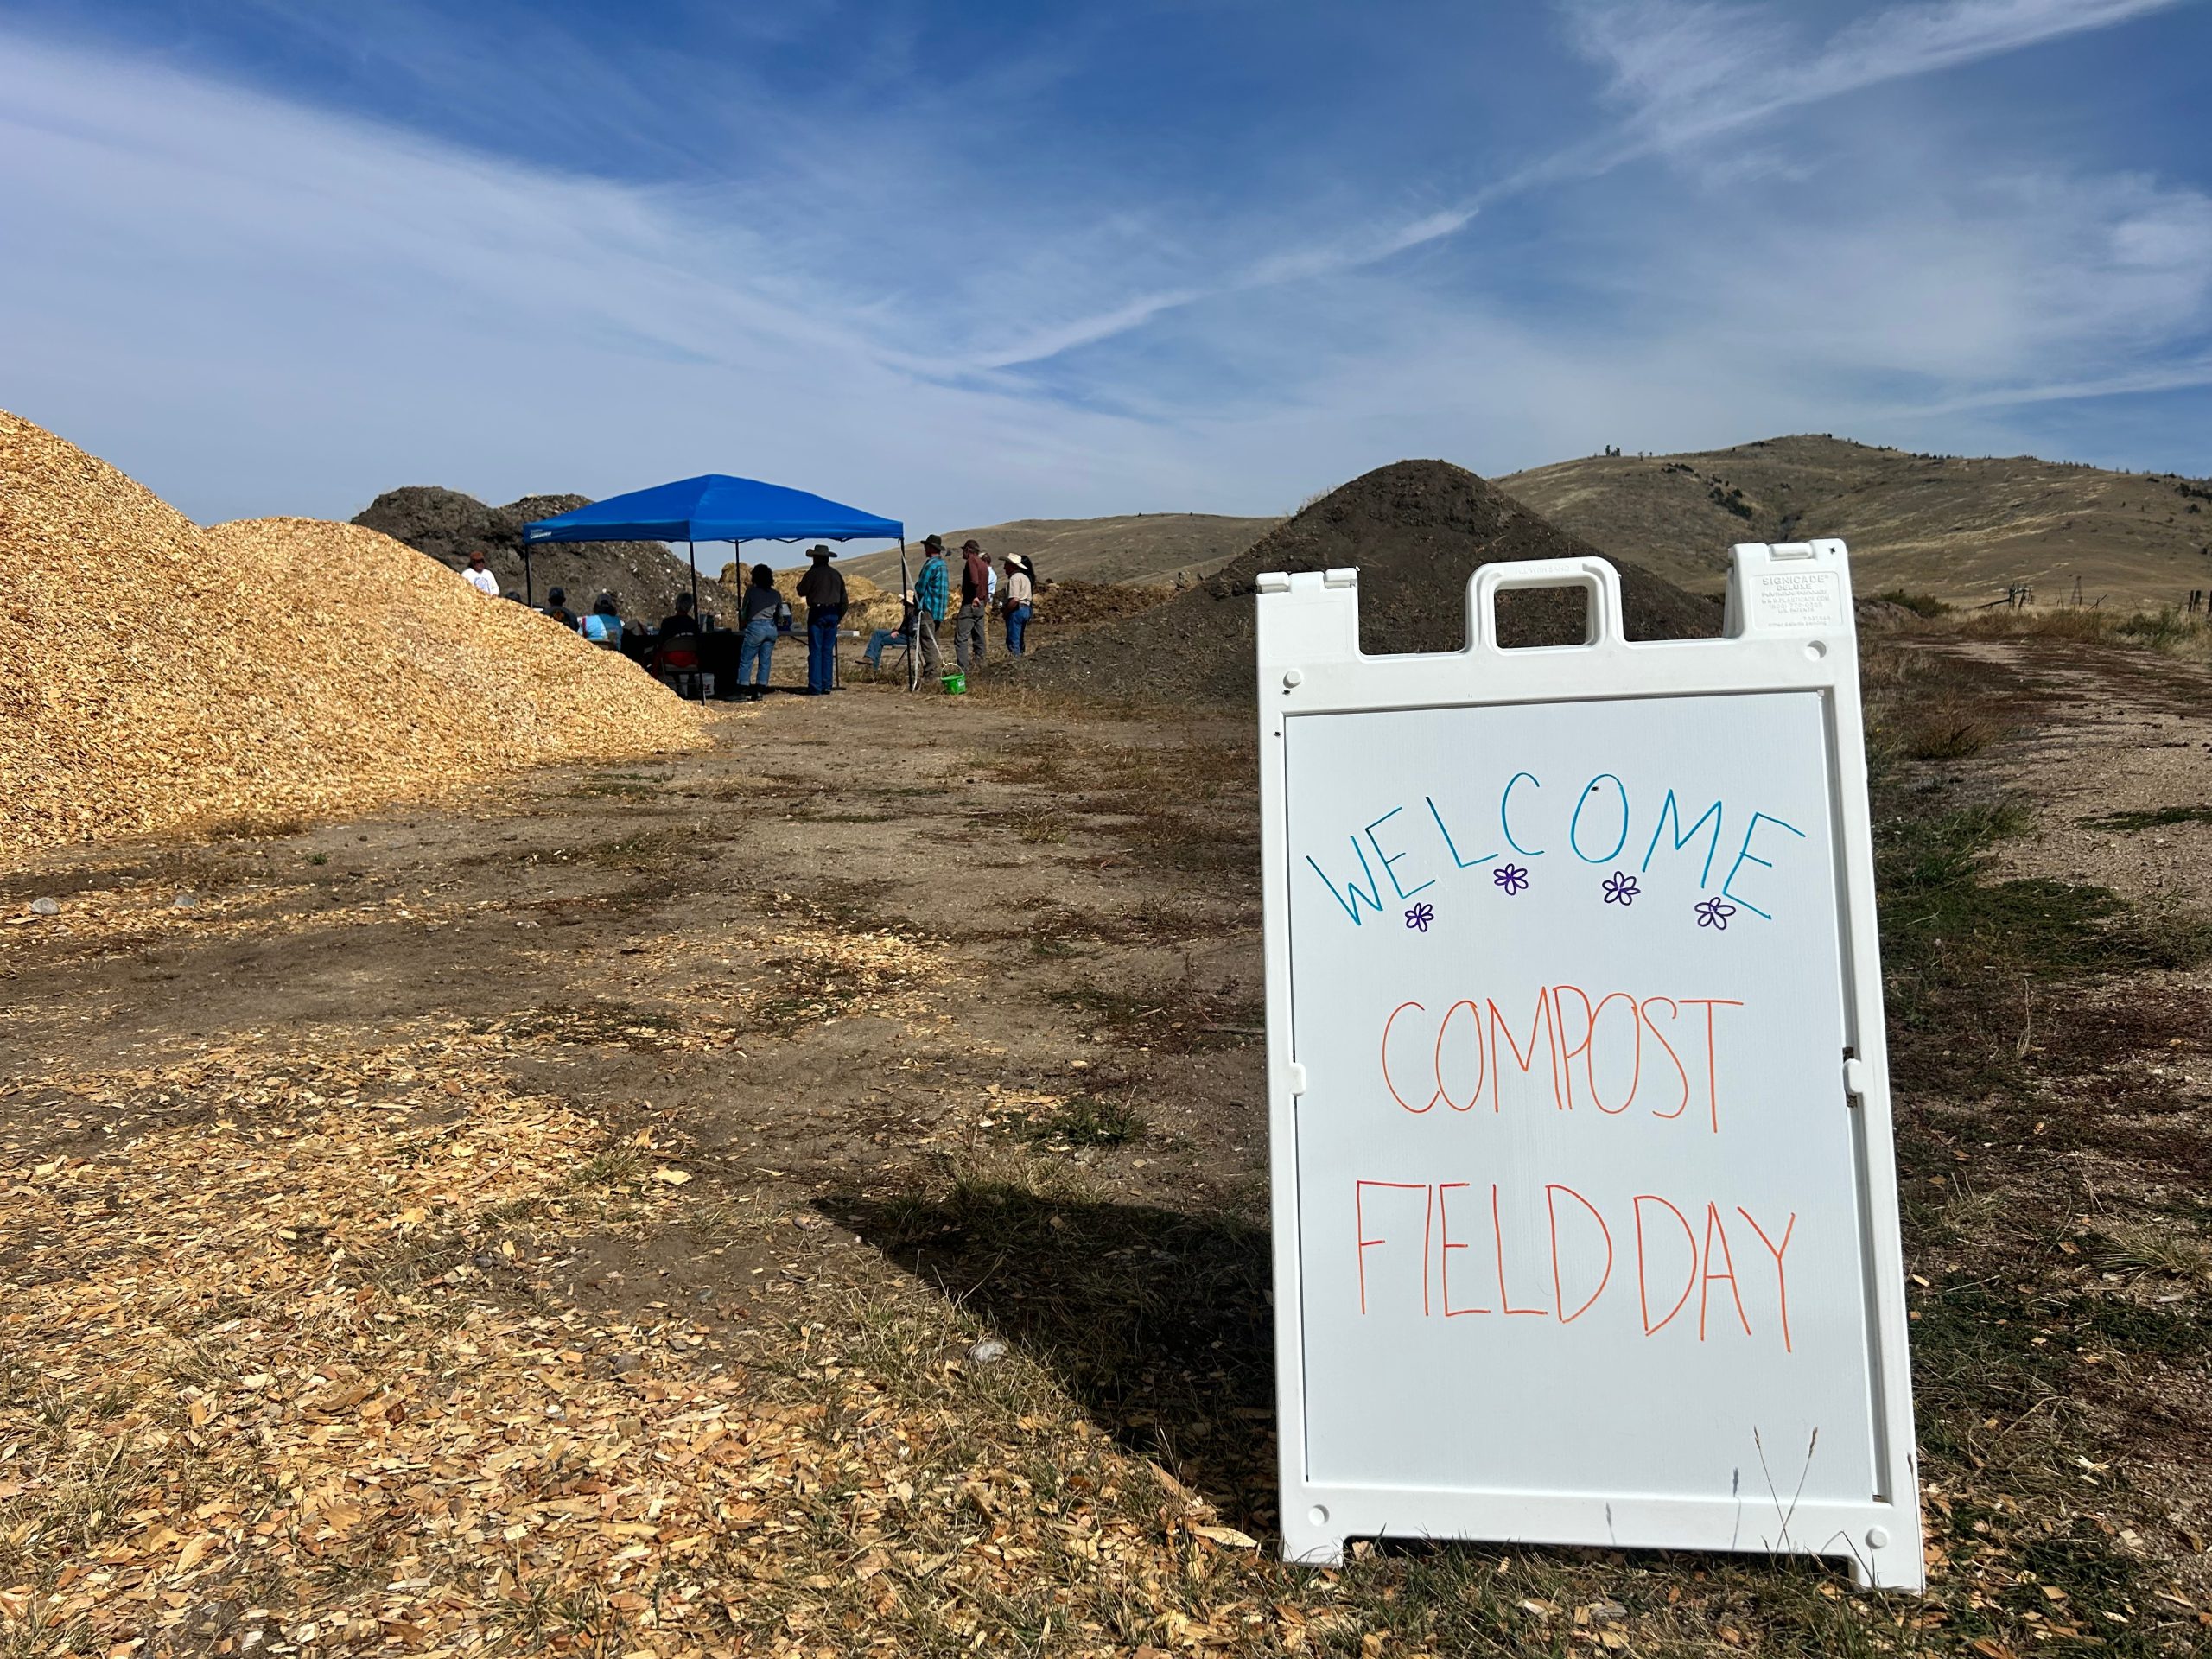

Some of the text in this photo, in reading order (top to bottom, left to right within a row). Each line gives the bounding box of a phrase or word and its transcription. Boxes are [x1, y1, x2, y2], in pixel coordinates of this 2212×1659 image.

[1307, 772, 1806, 927] WELCOME
[1382, 985, 1744, 1134] COMPOST
[1356, 1179, 1796, 1353] FIELD DAY
